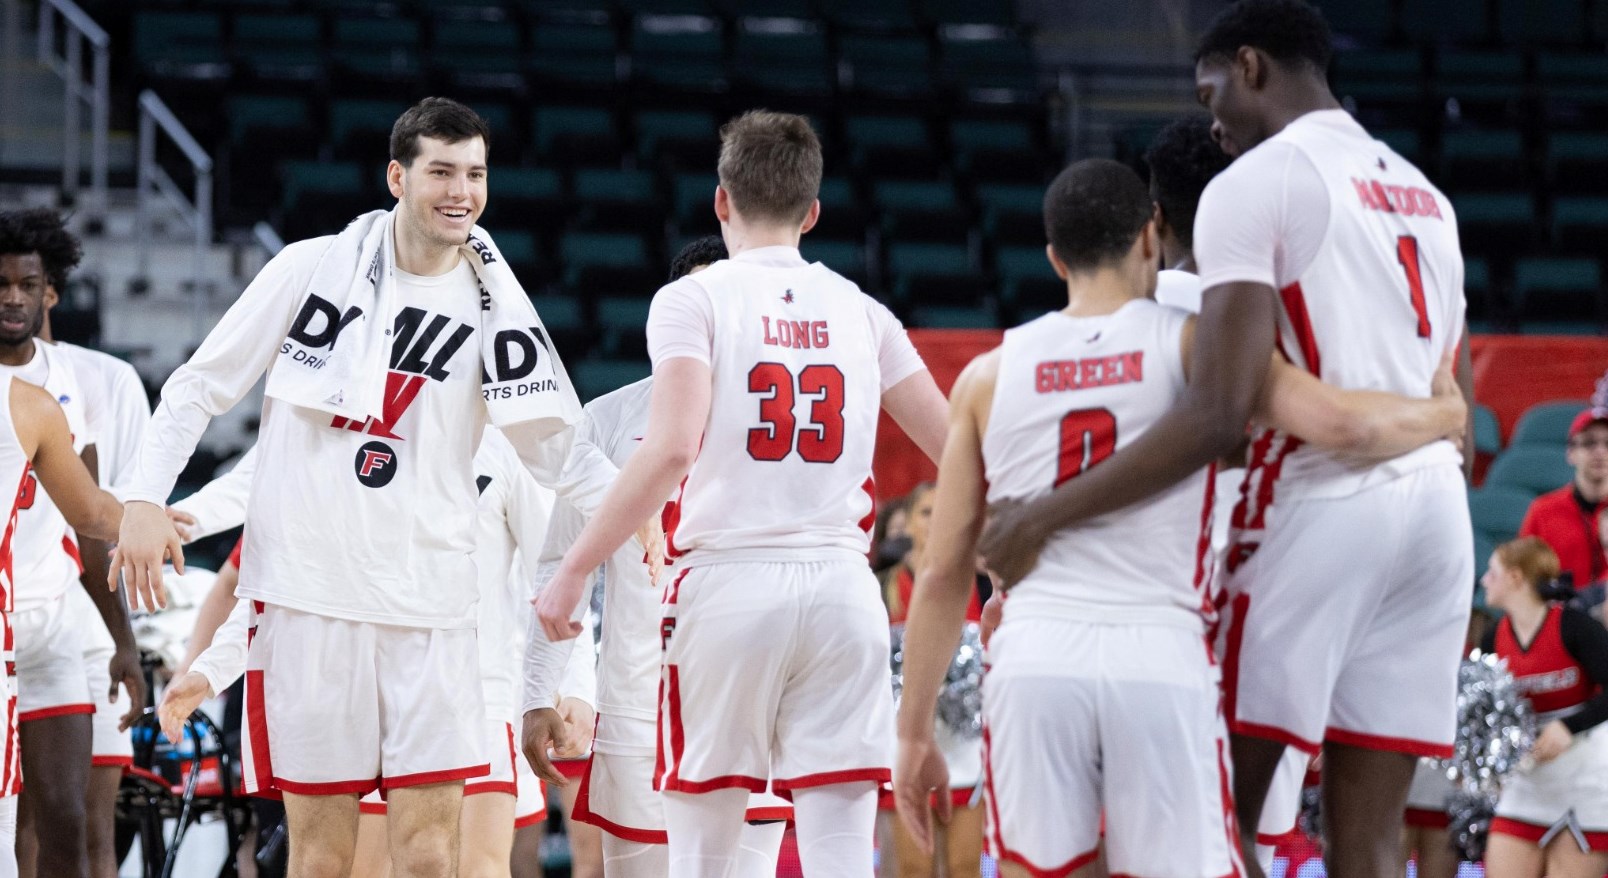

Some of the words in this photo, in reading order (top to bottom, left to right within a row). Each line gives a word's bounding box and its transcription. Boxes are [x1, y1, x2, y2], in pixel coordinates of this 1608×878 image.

[1397, 234, 1432, 338] 1
[761, 316, 829, 349] LONG
[482, 386, 512, 402] RTS
[517, 379, 559, 396] DRIN
[1035, 351, 1144, 394] GREEN
[747, 362, 845, 464] 33
[359, 449, 393, 477] F
